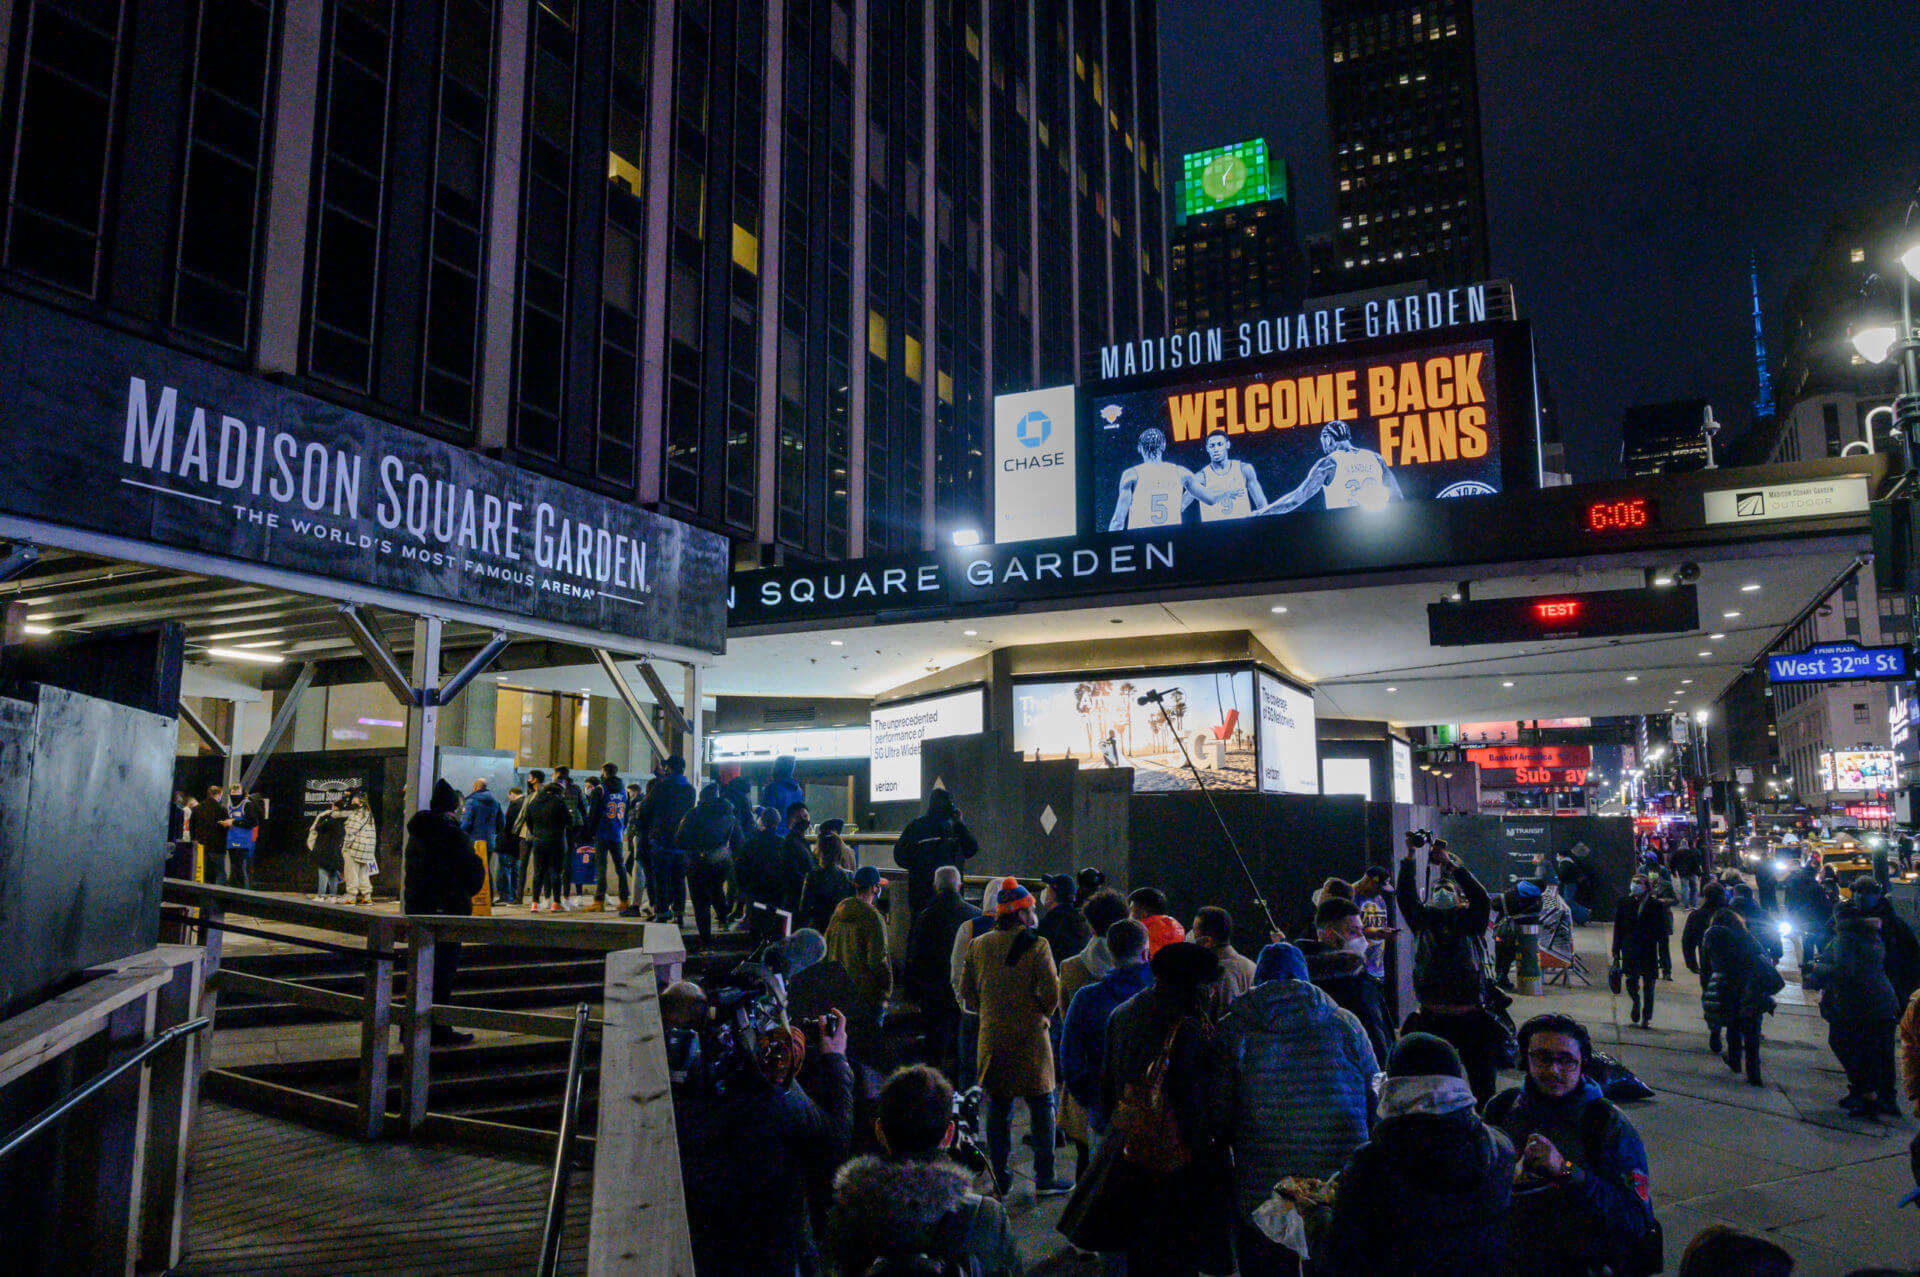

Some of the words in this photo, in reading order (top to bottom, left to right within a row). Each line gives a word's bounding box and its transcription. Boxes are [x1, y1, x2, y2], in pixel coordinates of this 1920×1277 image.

[1101, 327, 1223, 380] MADISON
[1239, 305, 1347, 358] SQUARE
[1365, 284, 1487, 338] GARDEN
[1167, 370, 1359, 442] WELCOME
[1368, 351, 1486, 417] BACK
[1378, 406, 1489, 466] FANS
[1004, 452, 1064, 472] CHASE
[122, 376, 362, 520] MADISON
[376, 455, 522, 561] SQUARE
[535, 503, 647, 592] GARDEN
[1769, 490, 1792, 498] MADISON
[1793, 488, 1812, 497] SQUARE
[1814, 487, 1835, 495] GARDEN
[1150, 493, 1169, 525] 5
[1771, 497, 1833, 509] OUTDOOR
[232, 505, 279, 528] THE
[291, 518, 393, 554] WORLD'S
[402, 545, 456, 568] MOST
[464, 560, 535, 587] FAMOUS
[760, 565, 940, 606] SQUARE
[966, 541, 1175, 586] GARDEN
[1538, 602, 1577, 617] TEST
[1775, 659, 1827, 677] West
[1831, 654, 1870, 675] 32nd
[1875, 654, 1898, 672] St
[874, 719, 887, 731] The
[887, 710, 938, 731] unprecedented
[875, 731, 917, 745] performance
[917, 726, 925, 739] of
[874, 747, 884, 760] 5G
[885, 745, 900, 758] Ultra
[1489, 753, 1508, 761] Bank
[1515, 766, 1588, 786] Subay
[875, 781, 898, 792] verizon
[607, 802, 626, 819] 33
